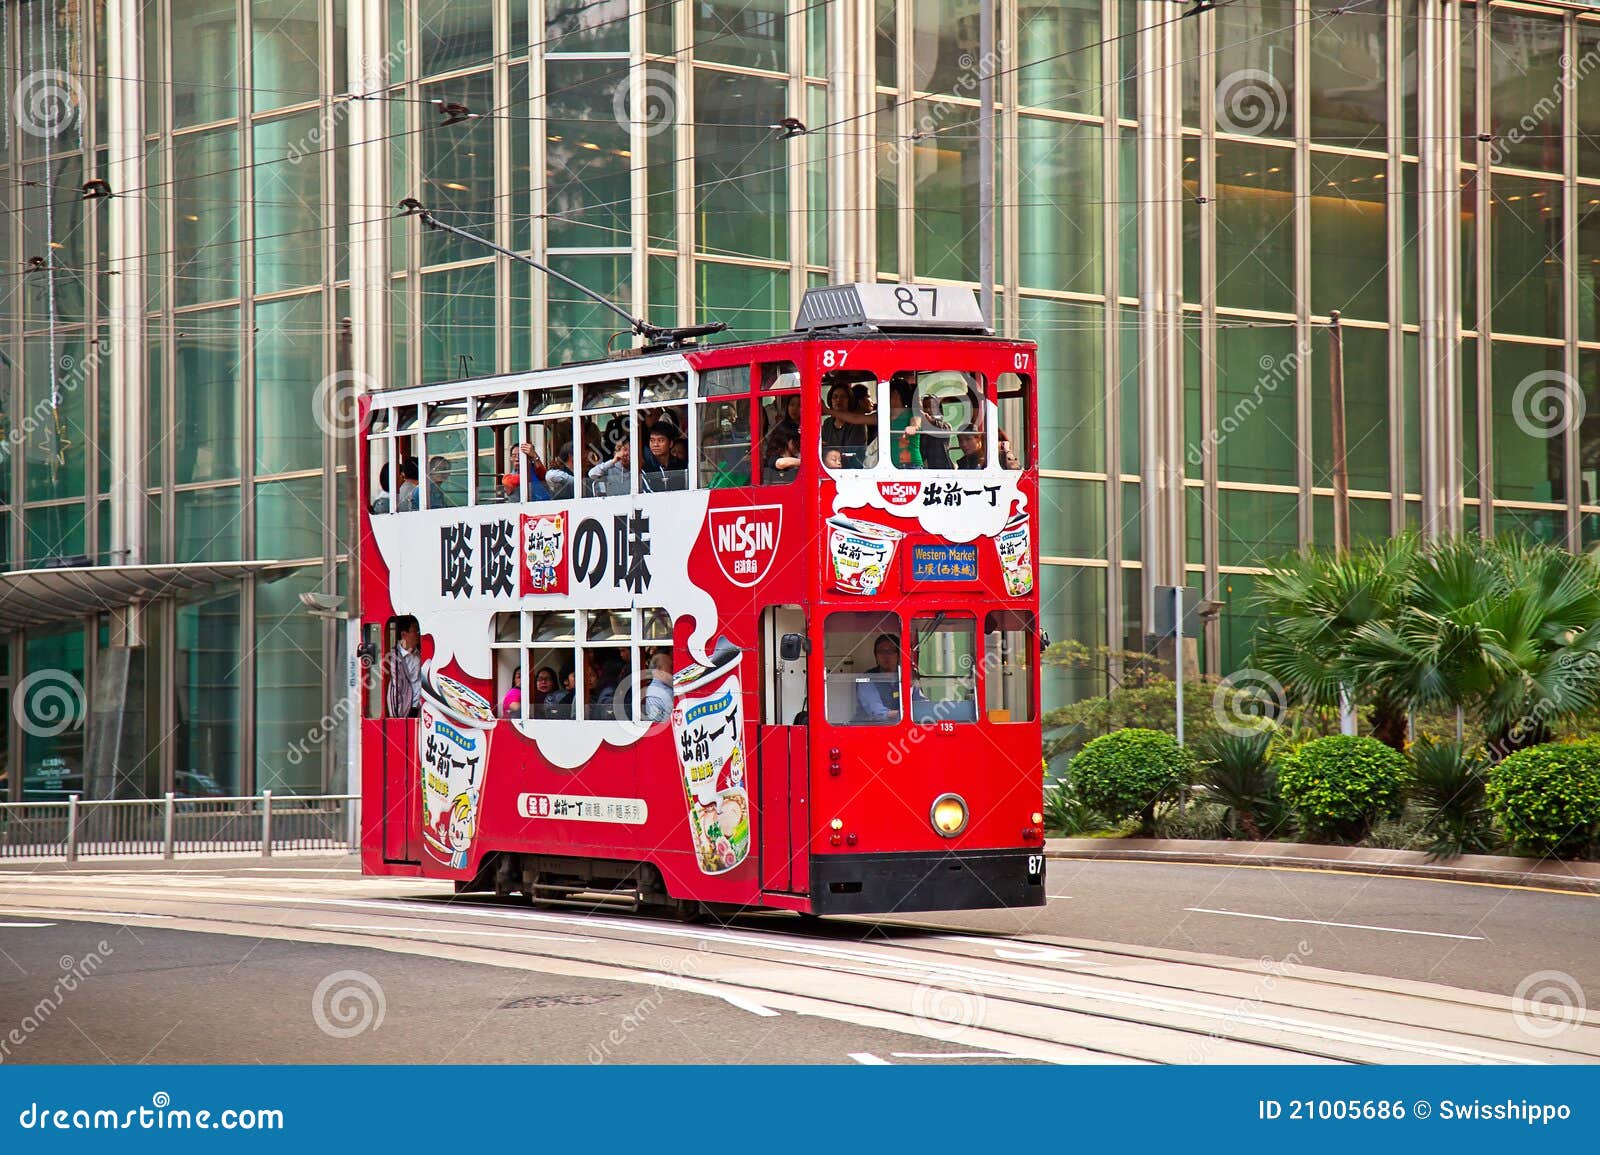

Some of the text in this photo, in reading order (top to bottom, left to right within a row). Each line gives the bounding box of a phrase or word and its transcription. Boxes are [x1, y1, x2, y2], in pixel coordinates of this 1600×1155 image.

[894, 287, 938, 317] 87
[822, 350, 848, 367] 87
[881, 483, 917, 498] NISSIN
[922, 481, 1001, 507] 出前一丁
[528, 531, 561, 551] 出前一丁
[718, 516, 773, 558] NISSIN
[999, 535, 1028, 555] 出前一丁
[572, 509, 652, 595] の味
[837, 543, 888, 562] 出前一丁
[915, 548, 976, 561] Western Market
[681, 704, 738, 762] 出前一丁
[940, 723, 954, 732] 135
[426, 734, 479, 785] 出前一丁
[554, 799, 583, 816] 出前一丁
[1028, 855, 1043, 875] 87
